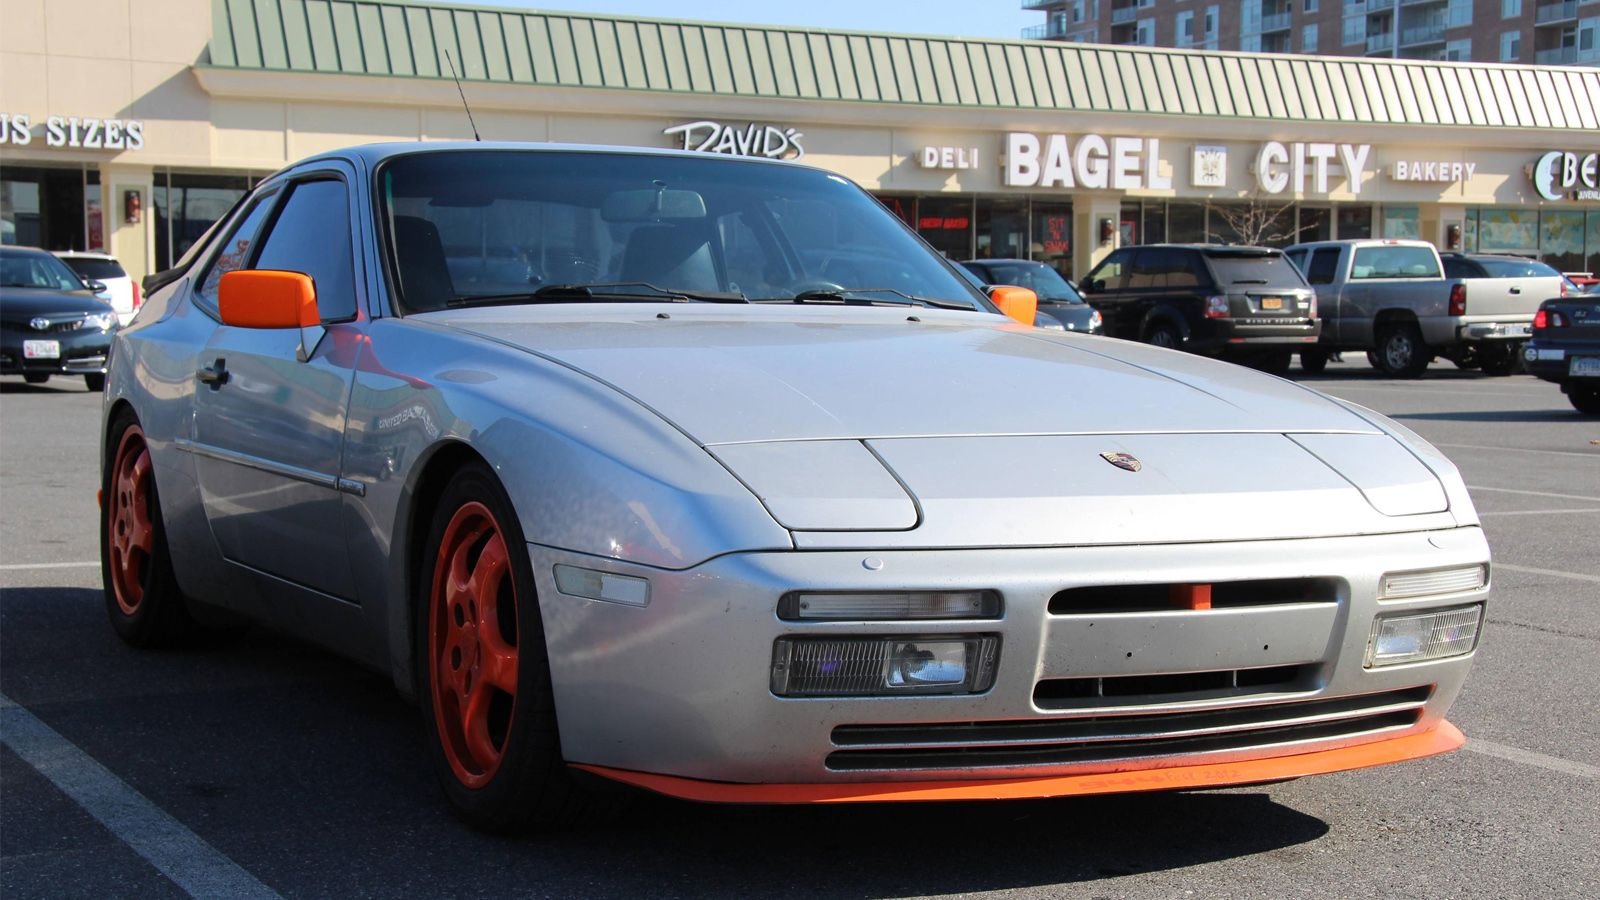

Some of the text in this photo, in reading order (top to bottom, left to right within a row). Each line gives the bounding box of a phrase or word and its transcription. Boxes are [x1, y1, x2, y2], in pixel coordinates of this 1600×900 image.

[46, 115, 144, 150] SIZES
[664, 121, 804, 161] DAVID'S
[923, 146, 979, 169] DELI
[1004, 132, 1372, 195] BAGEL CITY
[1395, 160, 1476, 182] BAKERY
[1562, 151, 1600, 189] BE
